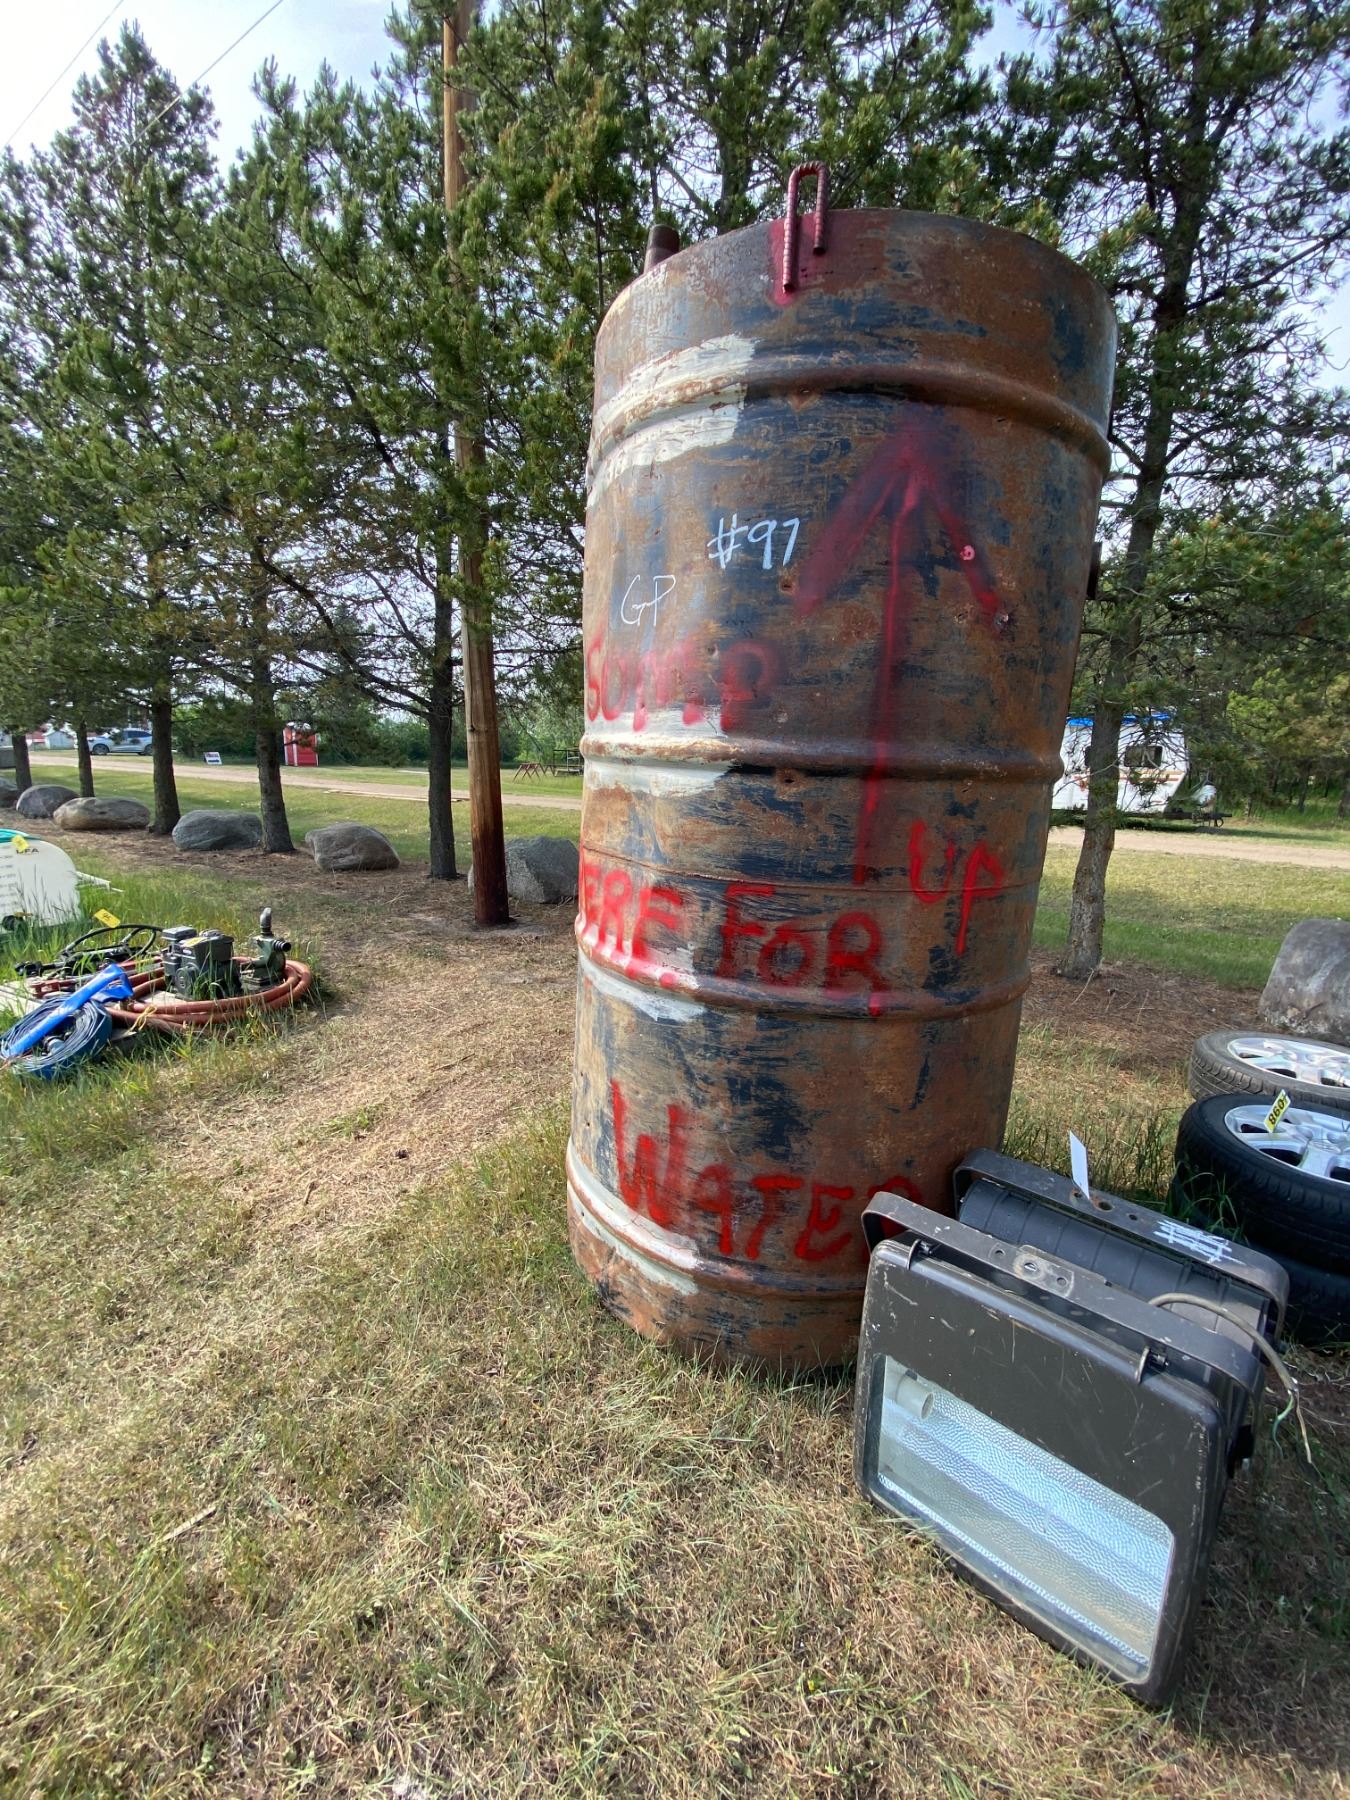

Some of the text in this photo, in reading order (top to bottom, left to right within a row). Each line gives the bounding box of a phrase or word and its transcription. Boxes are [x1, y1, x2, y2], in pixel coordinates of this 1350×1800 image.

[707, 513, 800, 570] #97
[620, 574, 677, 627] GP
[908, 820, 1005, 957] UP
[715, 881, 893, 1016] FOR
